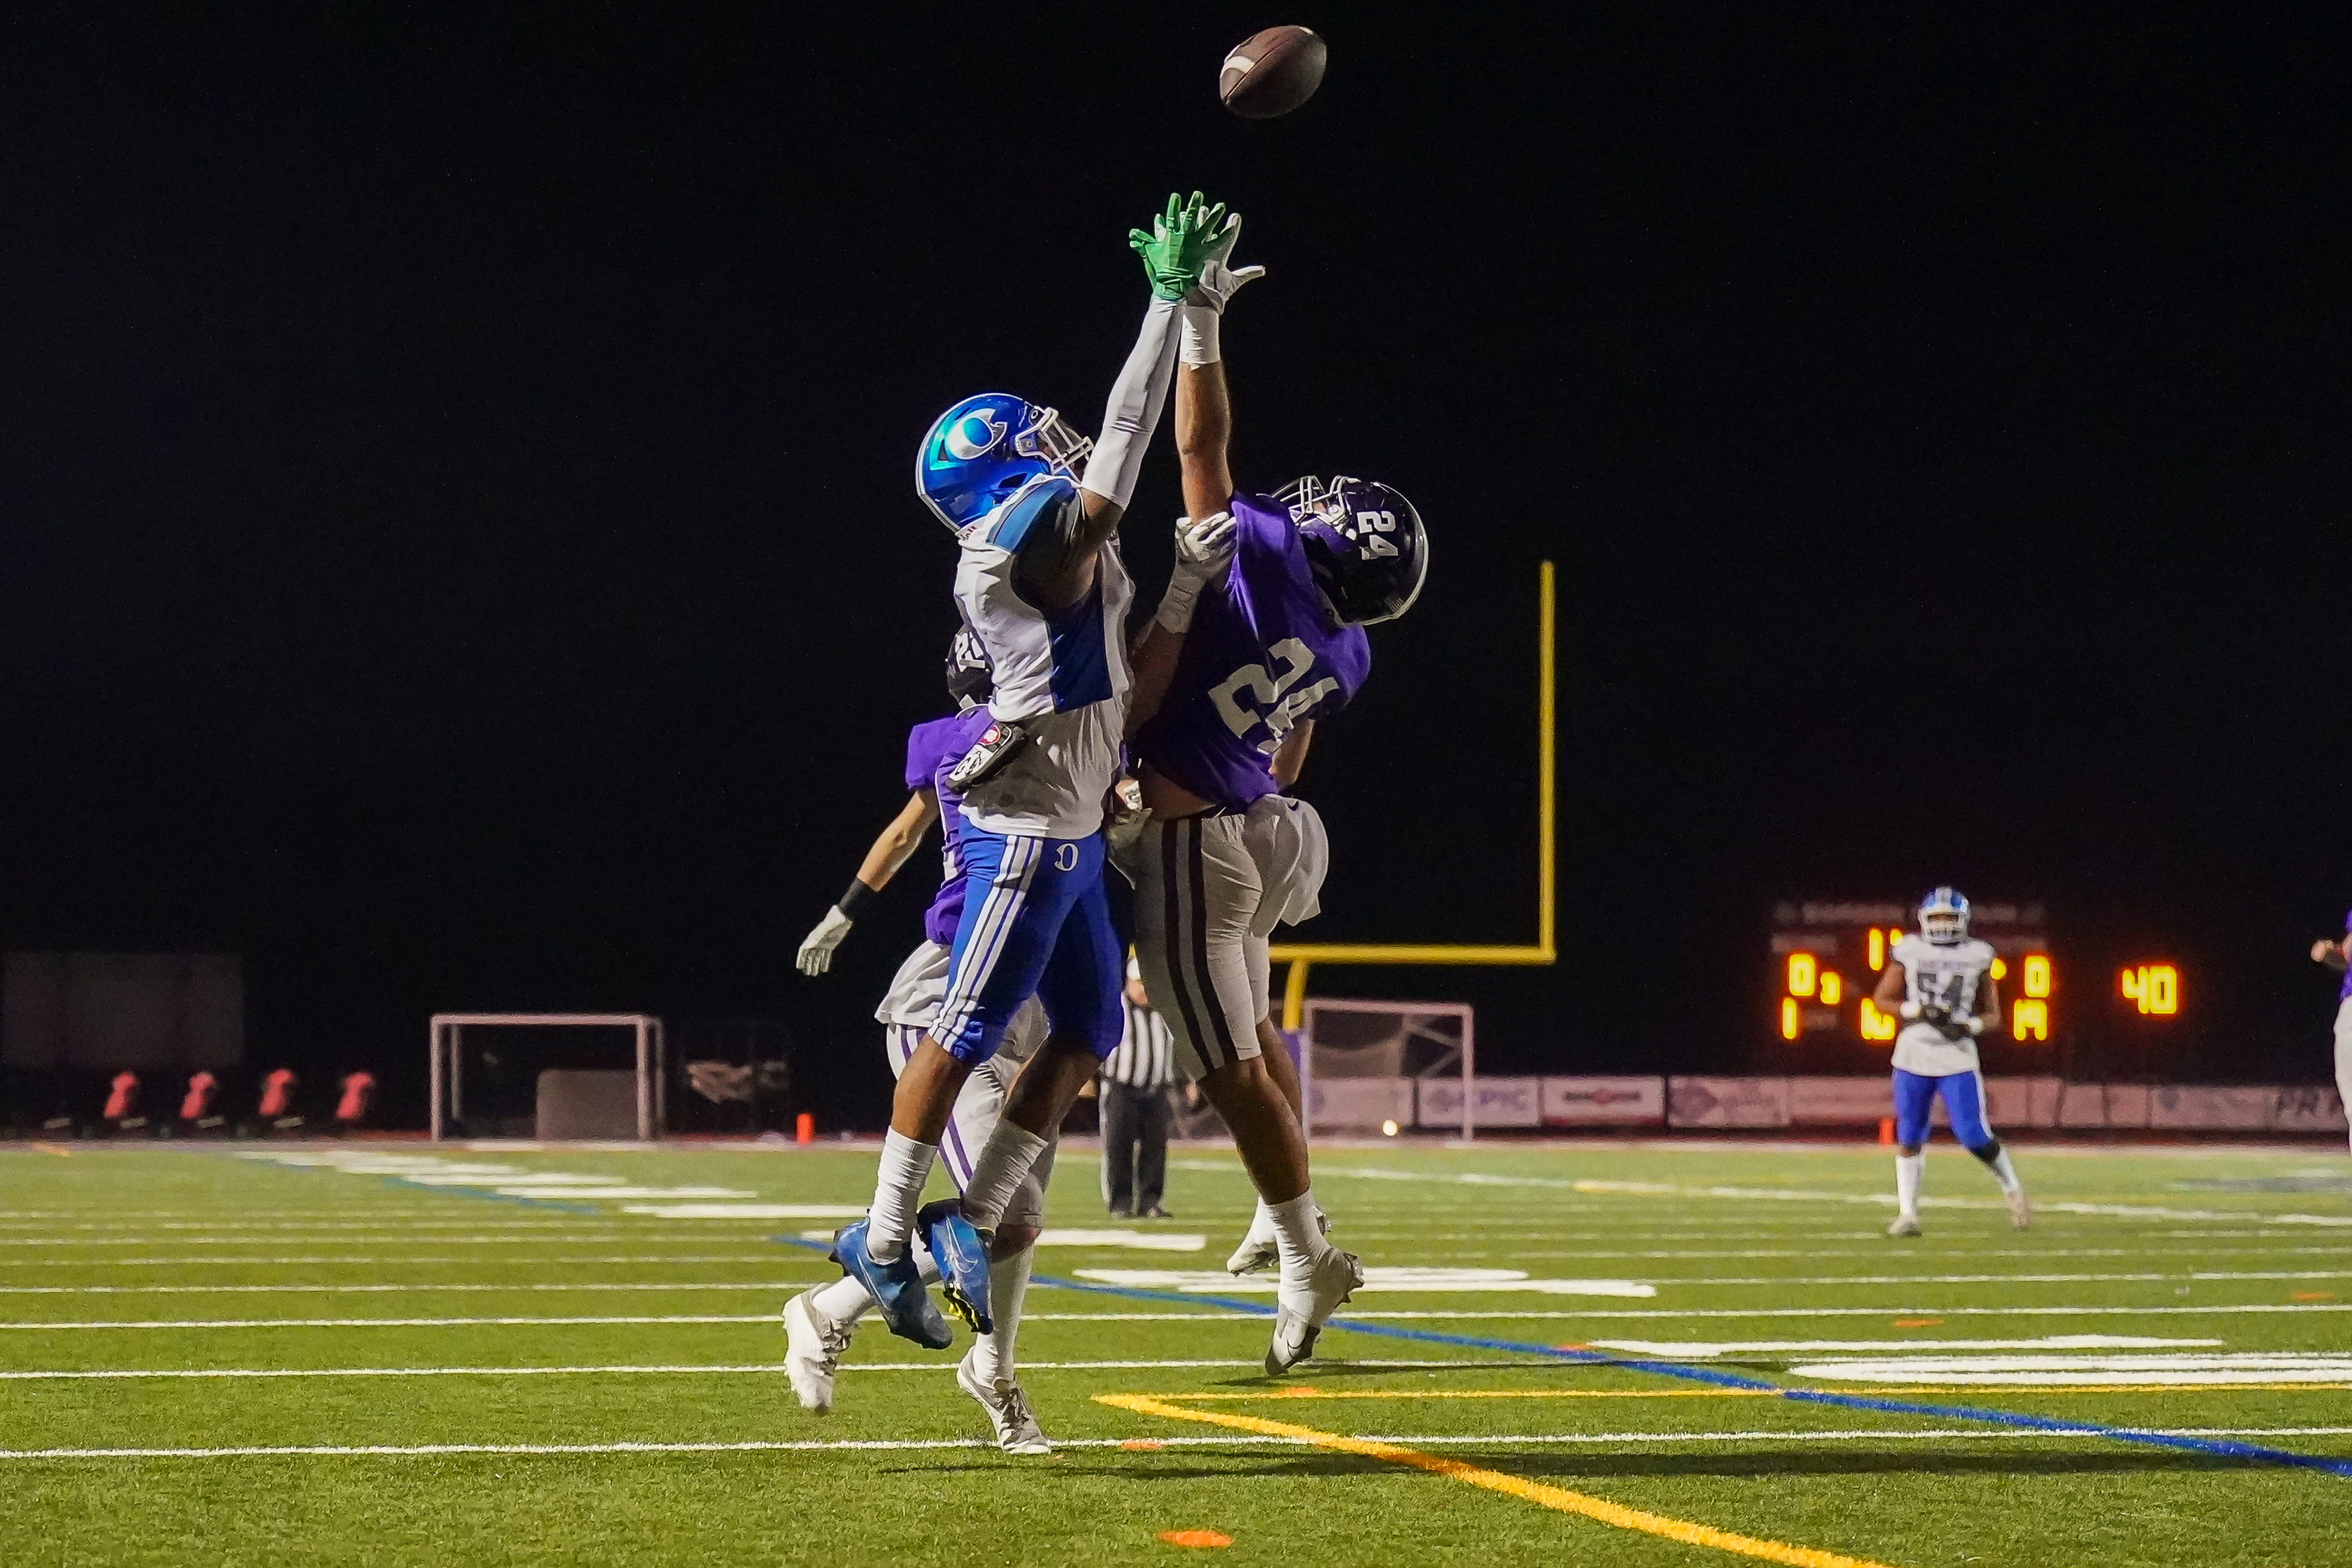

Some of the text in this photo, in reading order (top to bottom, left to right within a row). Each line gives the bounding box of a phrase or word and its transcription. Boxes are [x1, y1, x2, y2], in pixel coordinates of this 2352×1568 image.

[1357, 511, 1398, 560] 24
[1789, 954, 1815, 996] 0
[1917, 972, 1965, 1011] 54
[2025, 956, 2050, 997] 0
[2122, 966, 2177, 1014] 40
